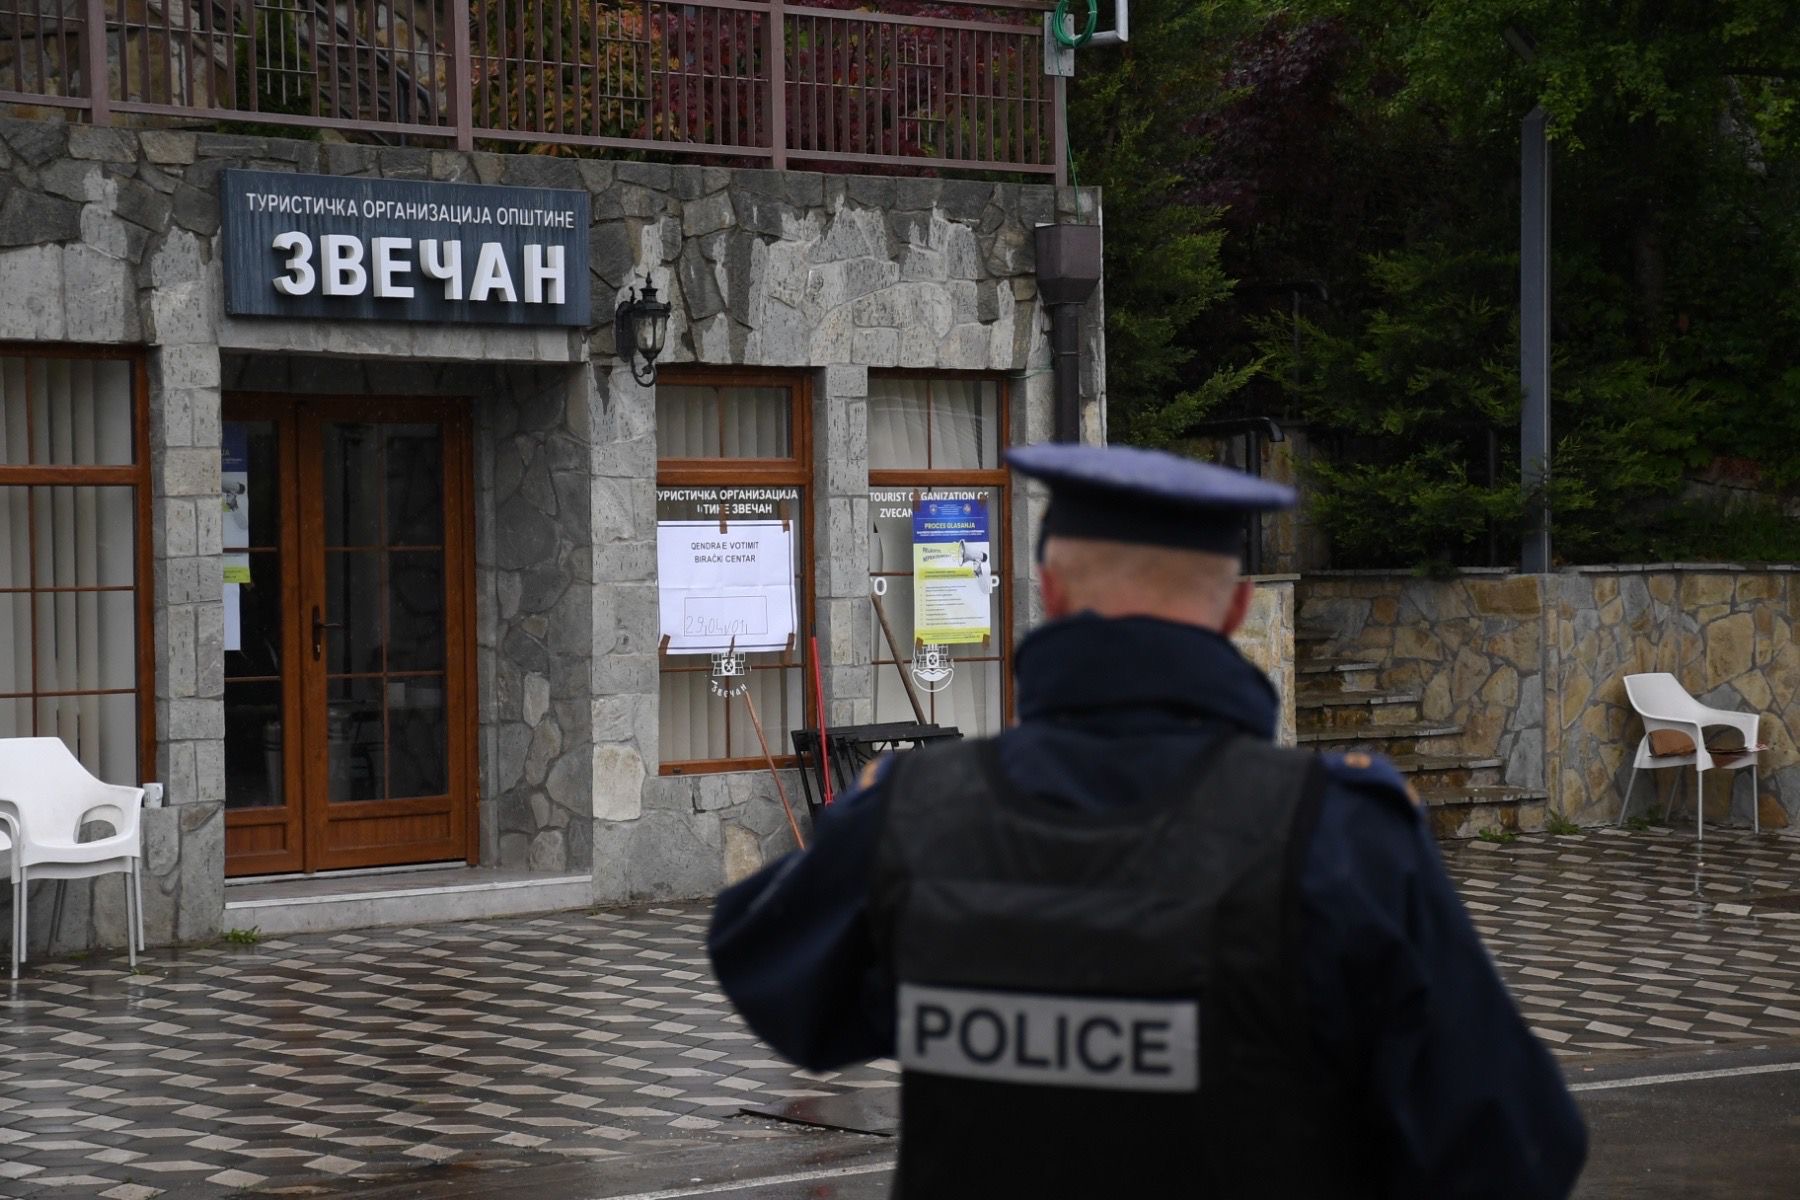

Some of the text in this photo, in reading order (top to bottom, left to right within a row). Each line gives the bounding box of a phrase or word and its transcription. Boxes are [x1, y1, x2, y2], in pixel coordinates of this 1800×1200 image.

[245, 192, 575, 229] ТУРИСТИЧКА ОРГАНИЗАЦИЈА ОПШТИНЕ
[271, 230, 566, 305] ЗВЕЧАН
[719, 489, 799, 500] ОРГАНИЗАЦИЈА
[869, 491, 906, 502] TOURIST
[908, 491, 975, 501] OGANIZATION
[732, 503, 773, 514] ЗВЕЧАН
[729, 541, 759, 550] VOTIMIT
[724, 554, 756, 563] CENTAR
[915, 1003, 1173, 1076] POLICE
